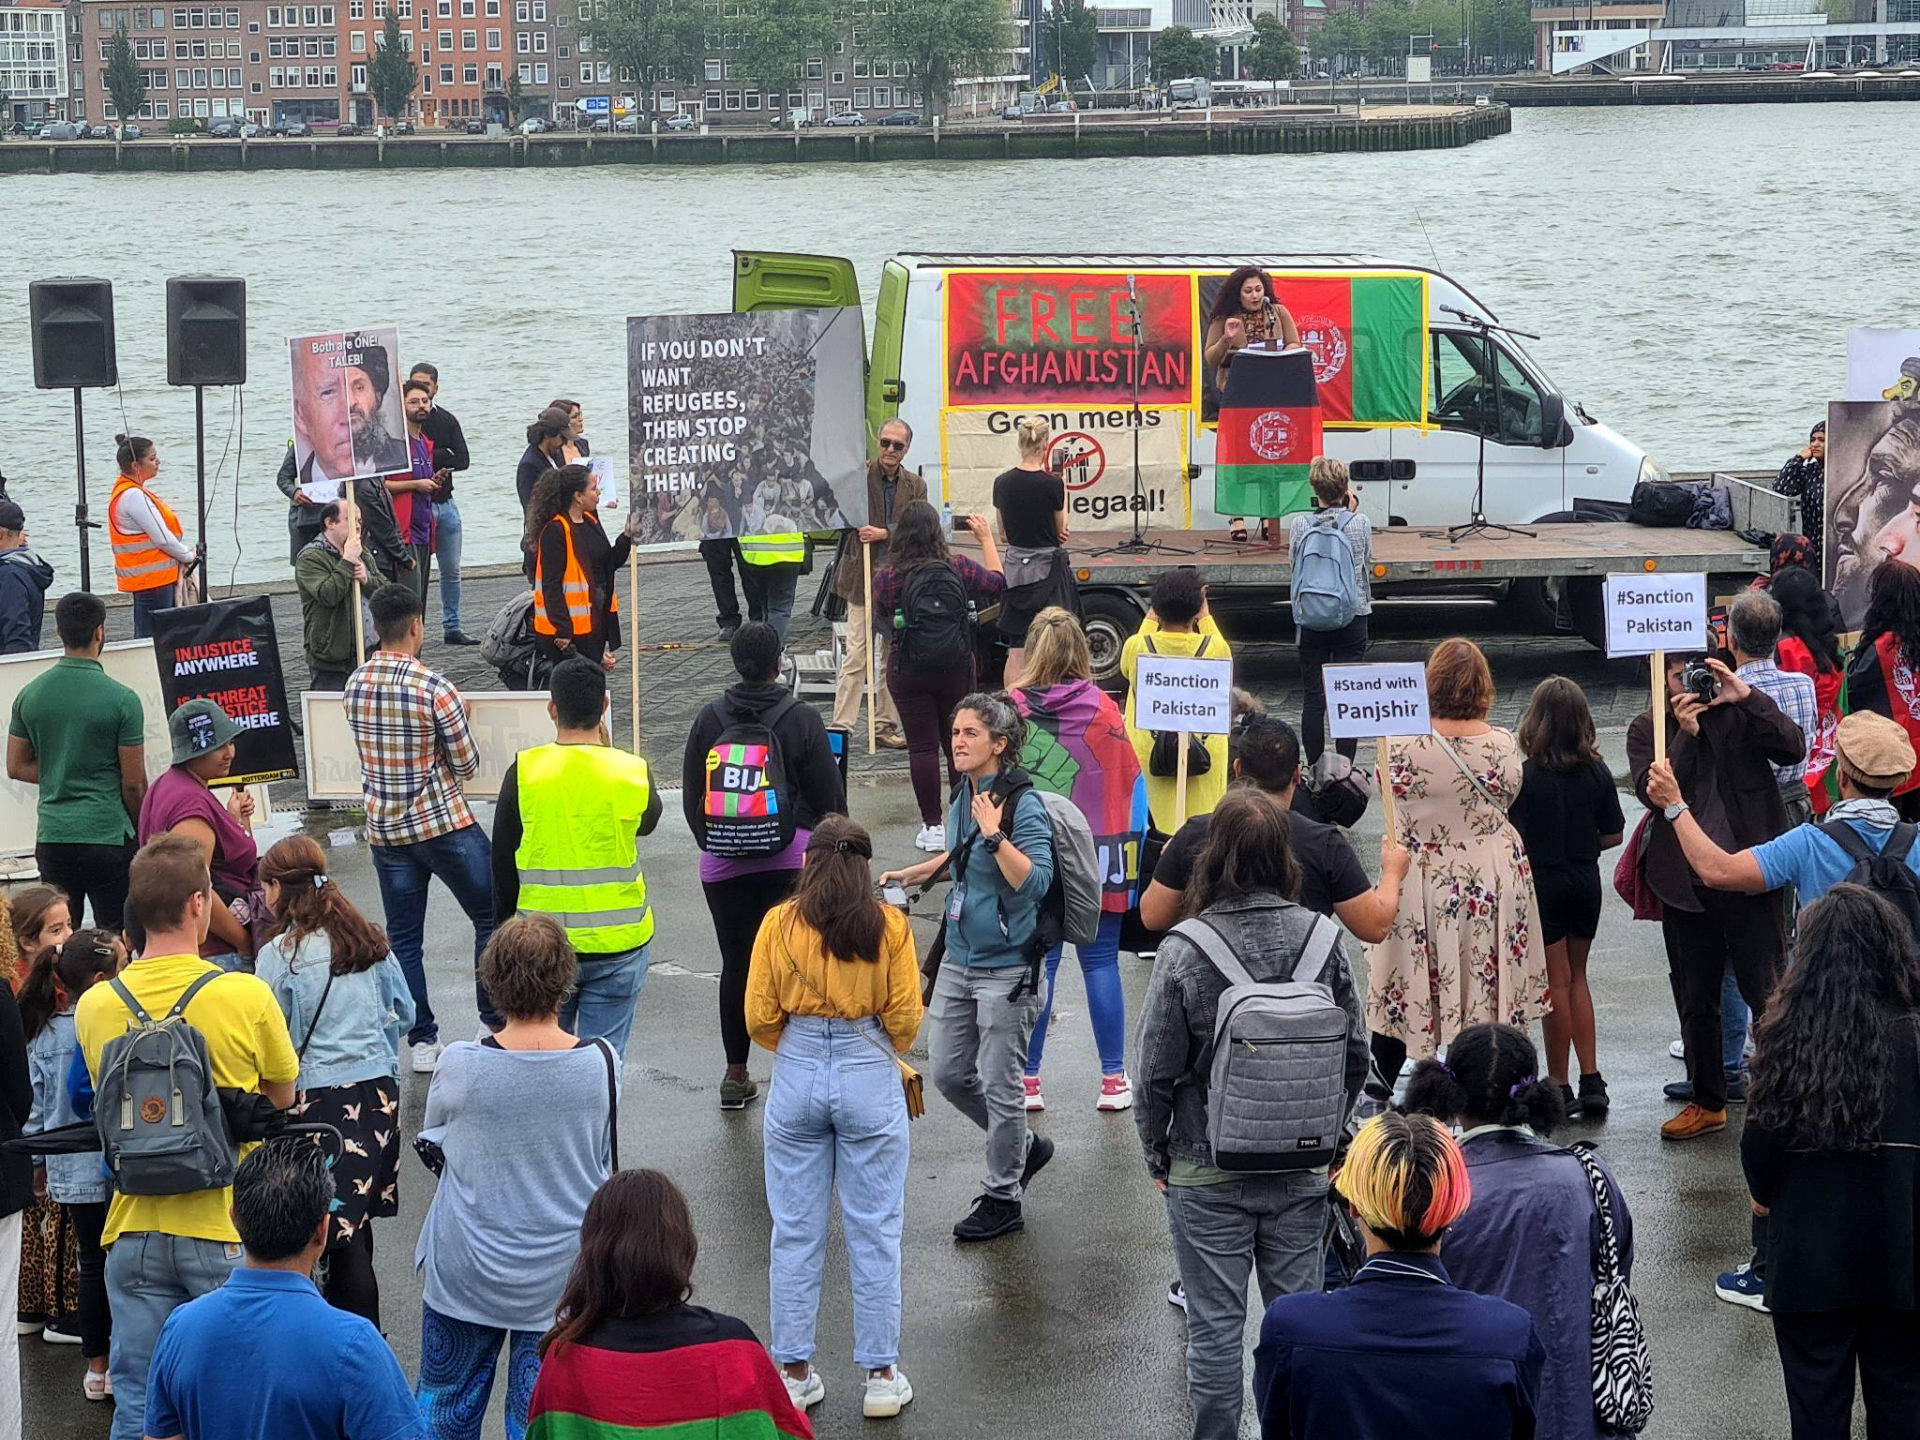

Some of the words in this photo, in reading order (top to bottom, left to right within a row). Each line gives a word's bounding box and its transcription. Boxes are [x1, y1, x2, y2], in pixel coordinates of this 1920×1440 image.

[995, 289, 1140, 346] FREE
[311, 340, 335, 353] Both
[338, 340, 353, 351] are
[354, 335, 379, 349] ONE!
[641, 342, 656, 361] IF
[659, 340, 696, 360] YOU
[328, 353, 364, 368] TALEB!
[954, 349, 1186, 387] AFGHANISTAN
[641, 367, 691, 388] WANT
[642, 390, 746, 414] REFUGEES,
[642, 419, 690, 440] THEN
[695, 416, 747, 437] STOP
[1079, 409, 1161, 429] mens
[643, 443, 736, 467] CREATING
[643, 471, 703, 492] THEM.
[1617, 589, 1694, 605] #Sanction
[1626, 618, 1692, 634] Pakistan
[175, 638, 253, 661] INJUSTICE
[174, 651, 259, 676] ANYWHERE
[1145, 672, 1219, 689] #Sanction
[1333, 677, 1382, 691] #Stand
[1385, 677, 1417, 689] with
[1152, 700, 1216, 717] Pakistan
[1337, 700, 1419, 722] Panjshir
[241, 772, 279, 782] ROTTERDAM
[1099, 841, 1138, 885] IJ1
